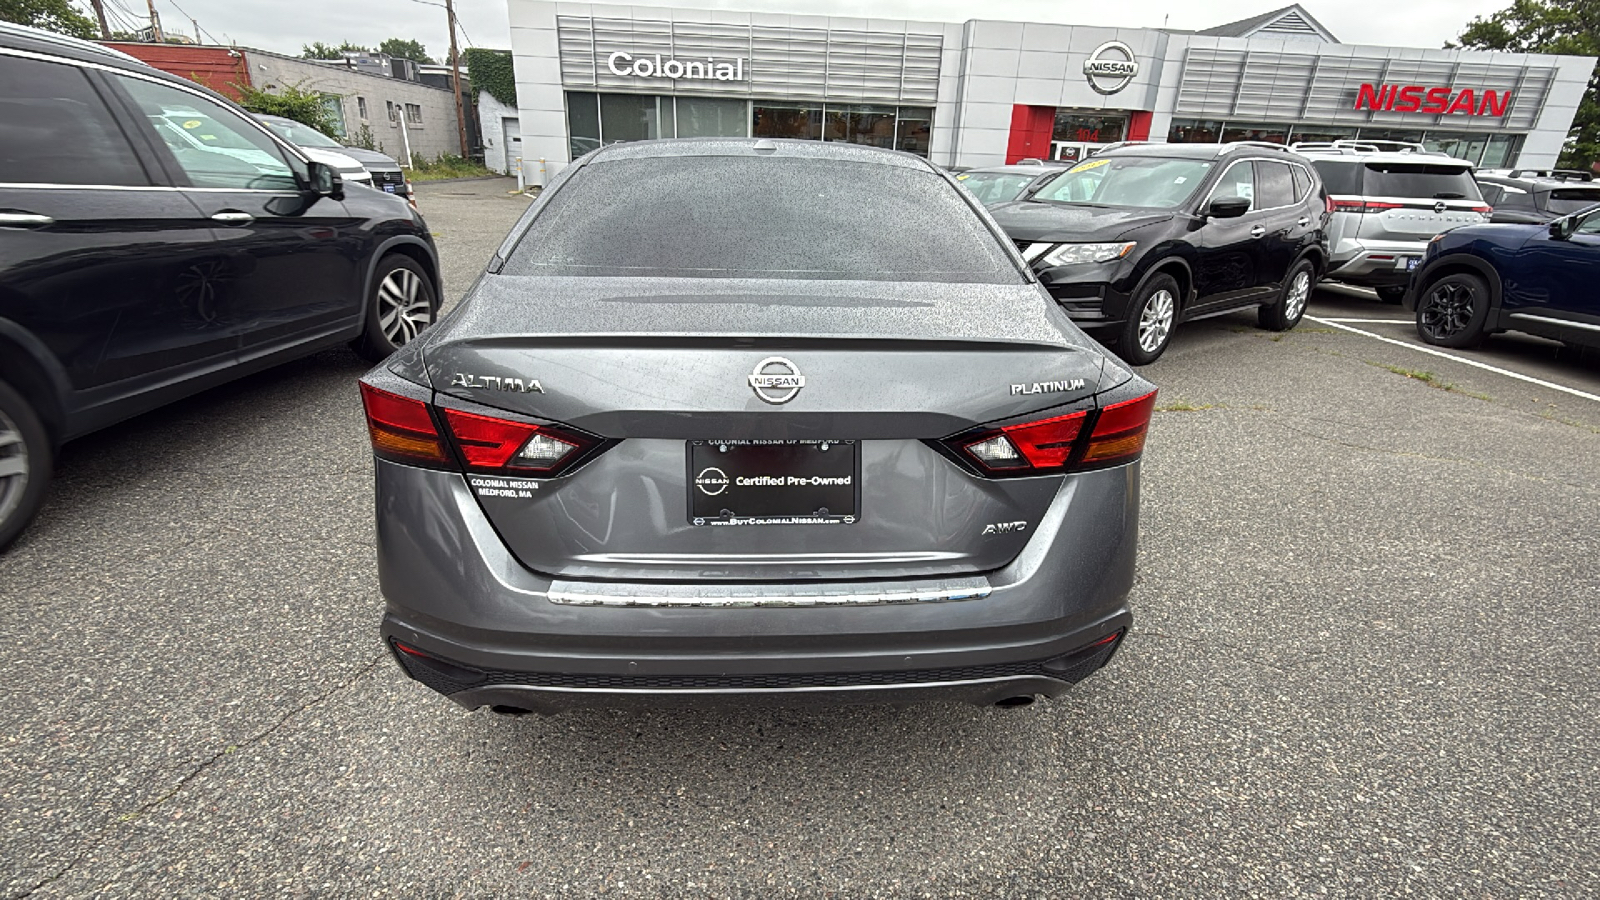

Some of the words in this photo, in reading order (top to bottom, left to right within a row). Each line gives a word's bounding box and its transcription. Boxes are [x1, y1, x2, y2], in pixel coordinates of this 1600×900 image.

[608, 51, 743, 81] Colonial
[1089, 62, 1134, 73] NISSAN
[1354, 83, 1512, 117] NISSAN
[1076, 127, 1099, 142] 104
[451, 373, 545, 394] ALTIMA
[754, 377, 799, 386] NISSAN
[1010, 378, 1085, 395] PLATINUM
[471, 478, 509, 488] COLONIAL
[509, 480, 539, 489] NISSAN
[736, 476, 785, 486] Certified
[787, 475, 852, 486] Pre-Owned
[478, 487, 518, 498] MEDFORD,
[518, 490, 533, 498] MA
[982, 521, 1028, 535] AWD
